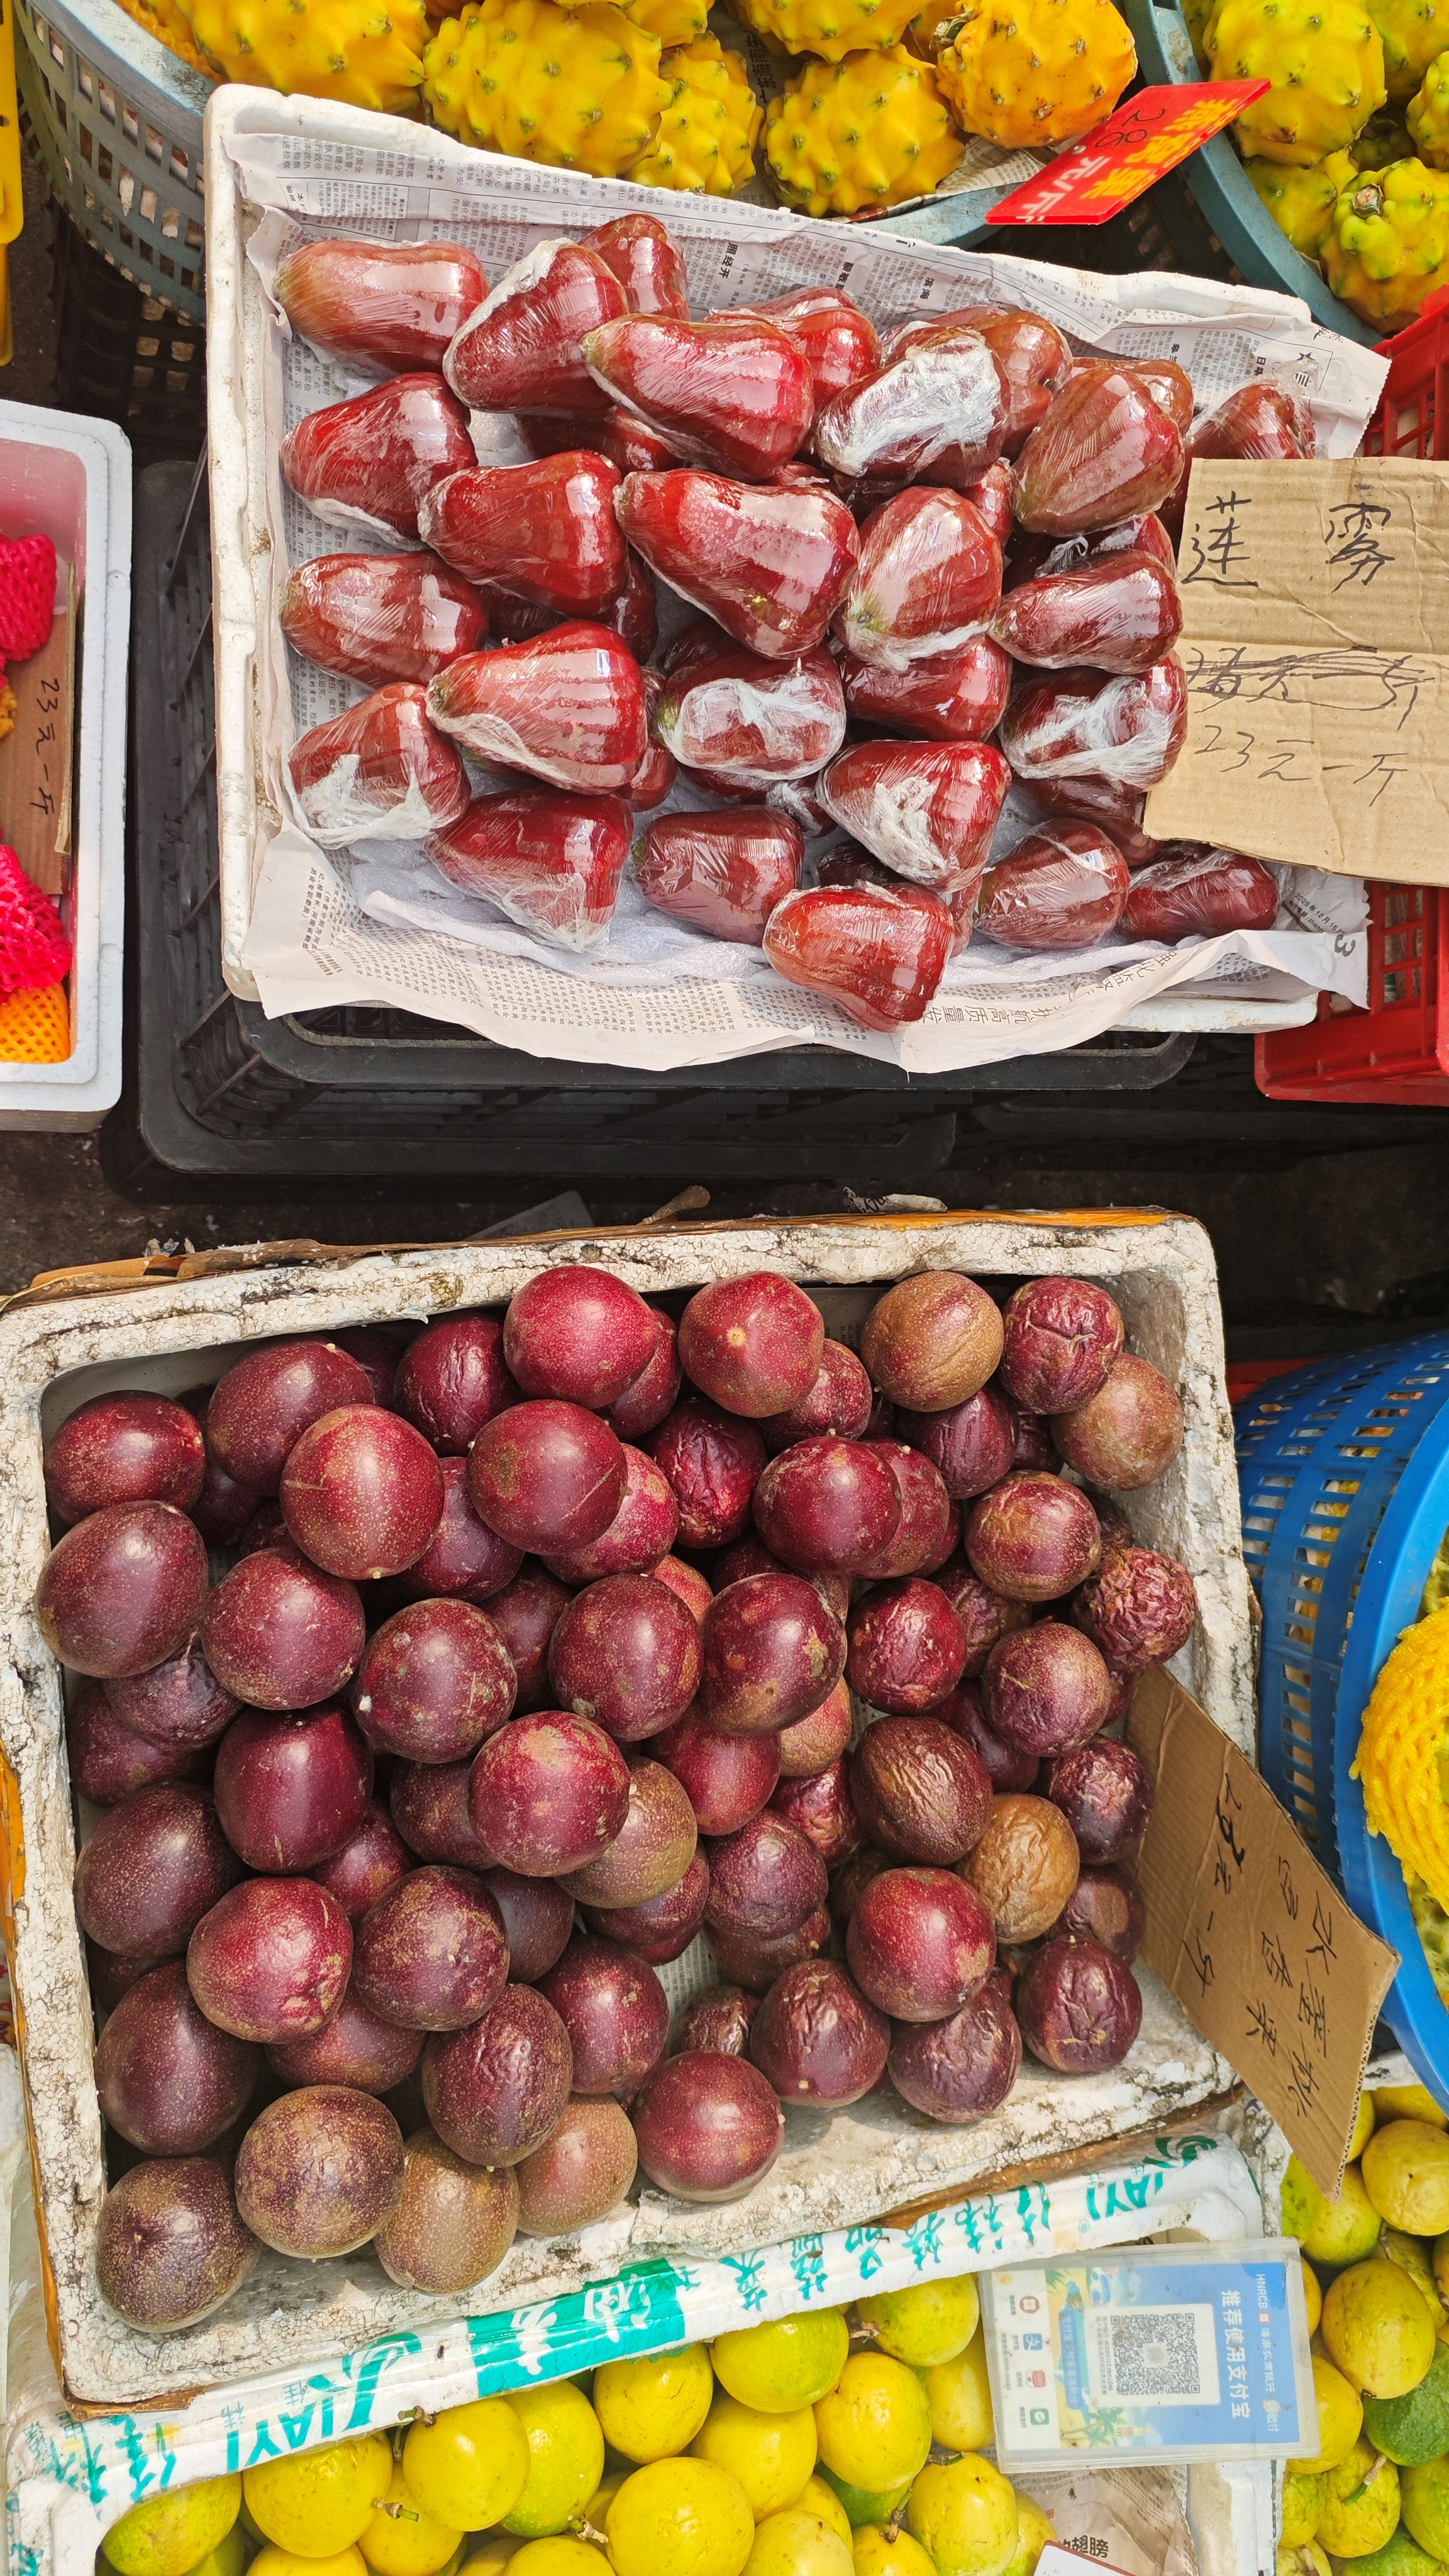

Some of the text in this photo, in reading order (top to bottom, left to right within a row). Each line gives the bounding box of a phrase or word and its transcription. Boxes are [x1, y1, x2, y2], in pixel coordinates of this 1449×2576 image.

[1080, 99, 1243, 199] 燕窝果
[1181, 491, 1396, 593] 莲雾
[29, 677, 60, 816] 23元一斤
[1194, 724, 1409, 807] 23元一斤
[1255, 2273, 1269, 2309] HNRCB
[1221, 2289, 1251, 2420] 推荐使用支付宝
